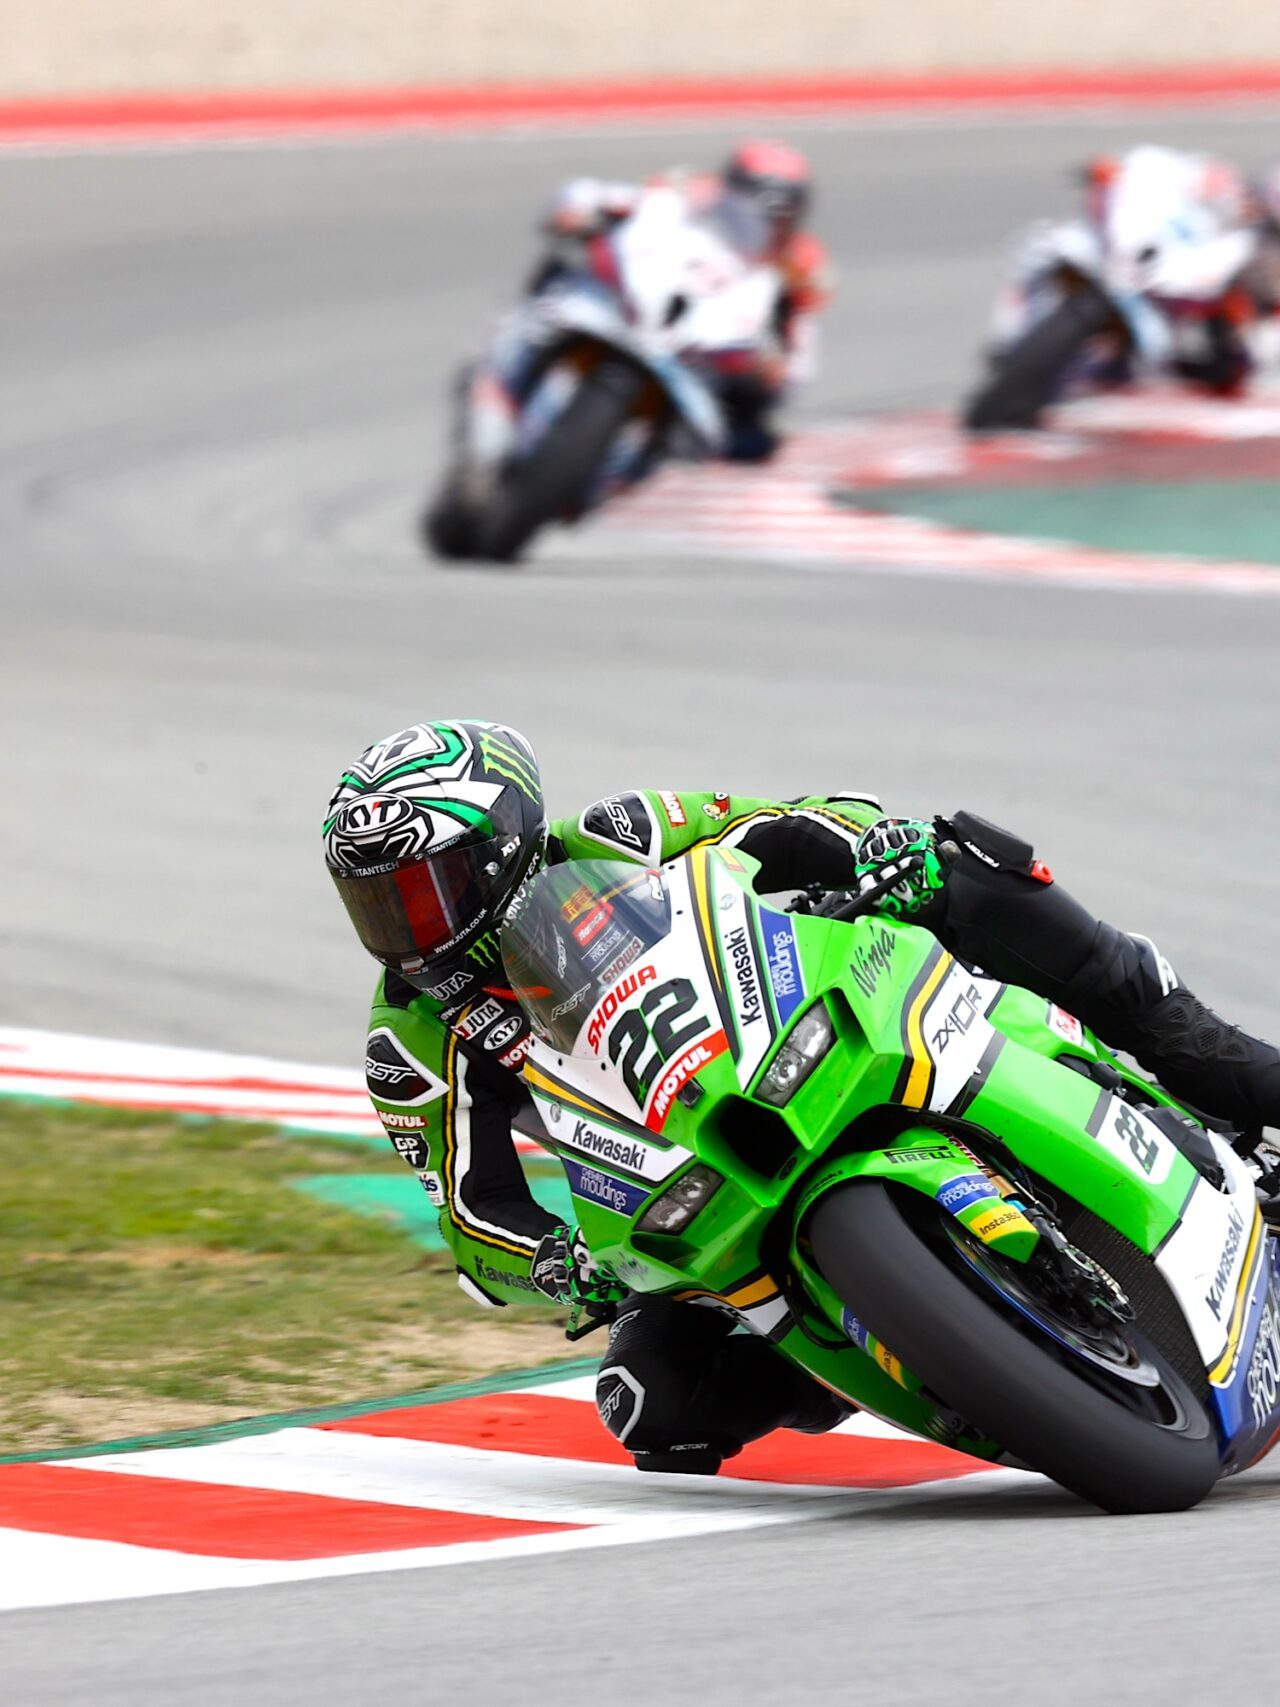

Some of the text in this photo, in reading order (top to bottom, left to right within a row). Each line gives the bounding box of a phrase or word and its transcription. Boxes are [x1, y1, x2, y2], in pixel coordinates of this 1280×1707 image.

[341, 799, 401, 833] KYT
[601, 798, 643, 848] RST
[658, 790, 686, 824] MOT
[351, 861, 400, 878] TITANTECH
[601, 938, 641, 985] SHOWA
[724, 926, 763, 1027] Kawasaki
[849, 923, 896, 999] Ninja
[466, 1003, 501, 1034] JUTA
[587, 964, 658, 1056] SHOWA
[487, 1018, 515, 1048] KYT
[498, 1034, 534, 1067] MOT
[608, 977, 712, 1113] 22
[653, 1044, 713, 1119] MOTUL
[378, 1110, 426, 1128] MOTUL
[394, 1136, 419, 1151] GP
[572, 1119, 647, 1171] Kawasaki
[883, 1145, 957, 1165] PIRELLI
[1114, 1103, 1160, 1176] 22
[580, 1174, 628, 1211] mouldings
[978, 1210, 1023, 1236] Insta360
[474, 1255, 538, 1293] Kawasa
[533, 1256, 555, 1279] RS
